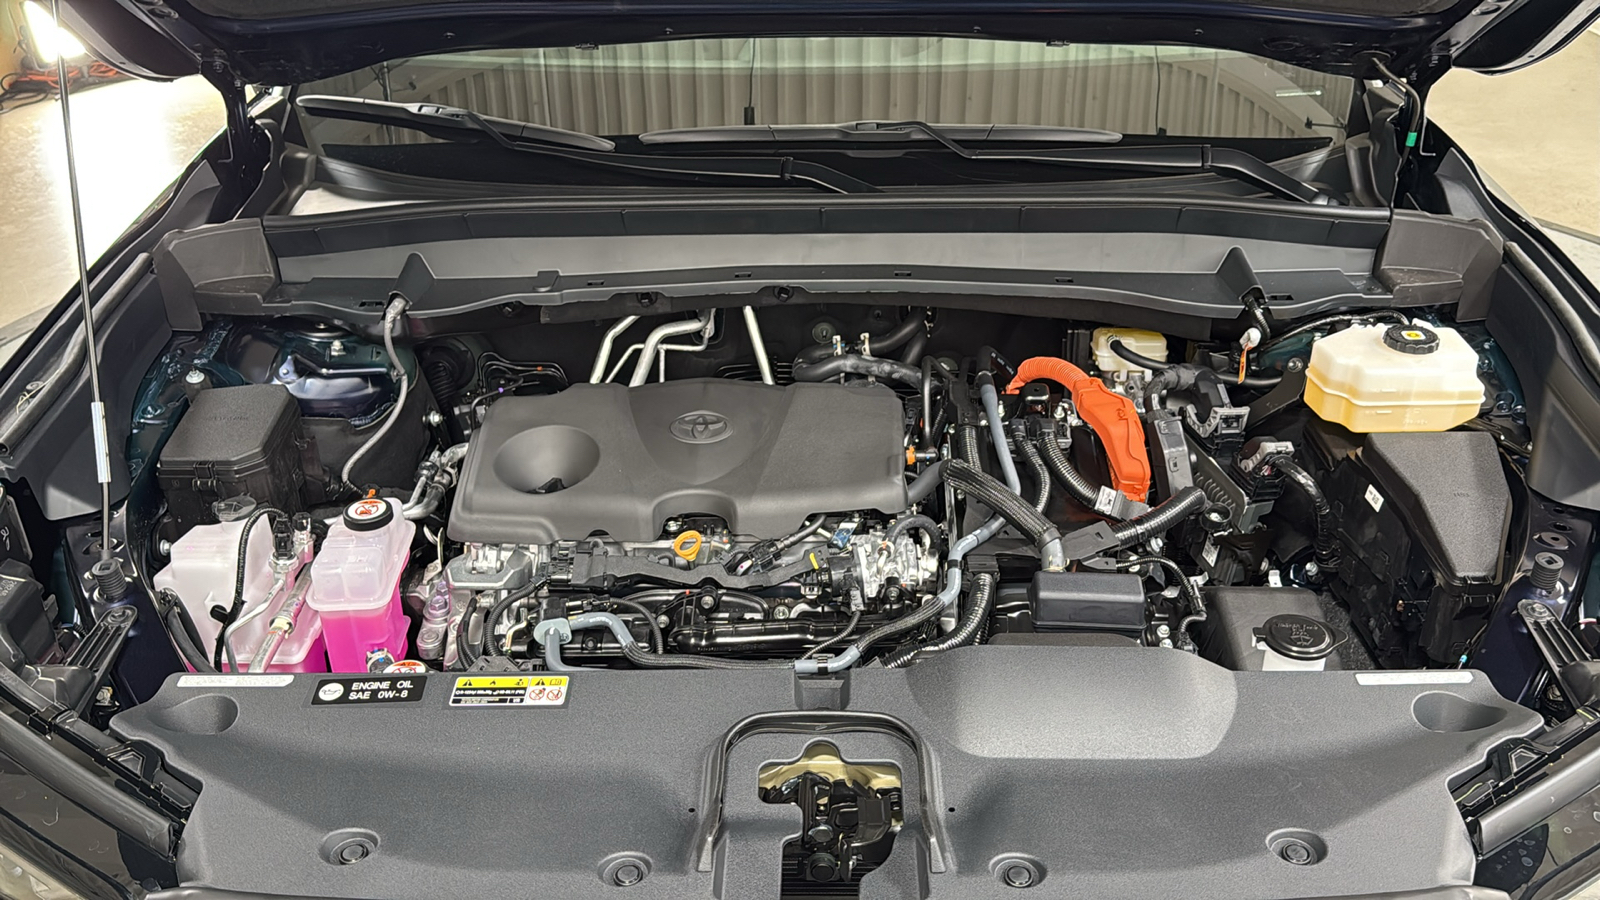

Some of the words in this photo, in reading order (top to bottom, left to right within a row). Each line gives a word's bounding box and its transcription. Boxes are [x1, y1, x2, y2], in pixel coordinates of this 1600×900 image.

[351, 681, 391, 690] ENGINE
[396, 680, 414, 689] OIL
[348, 691, 371, 700] SAE
[377, 690, 409, 699] 0W-8
